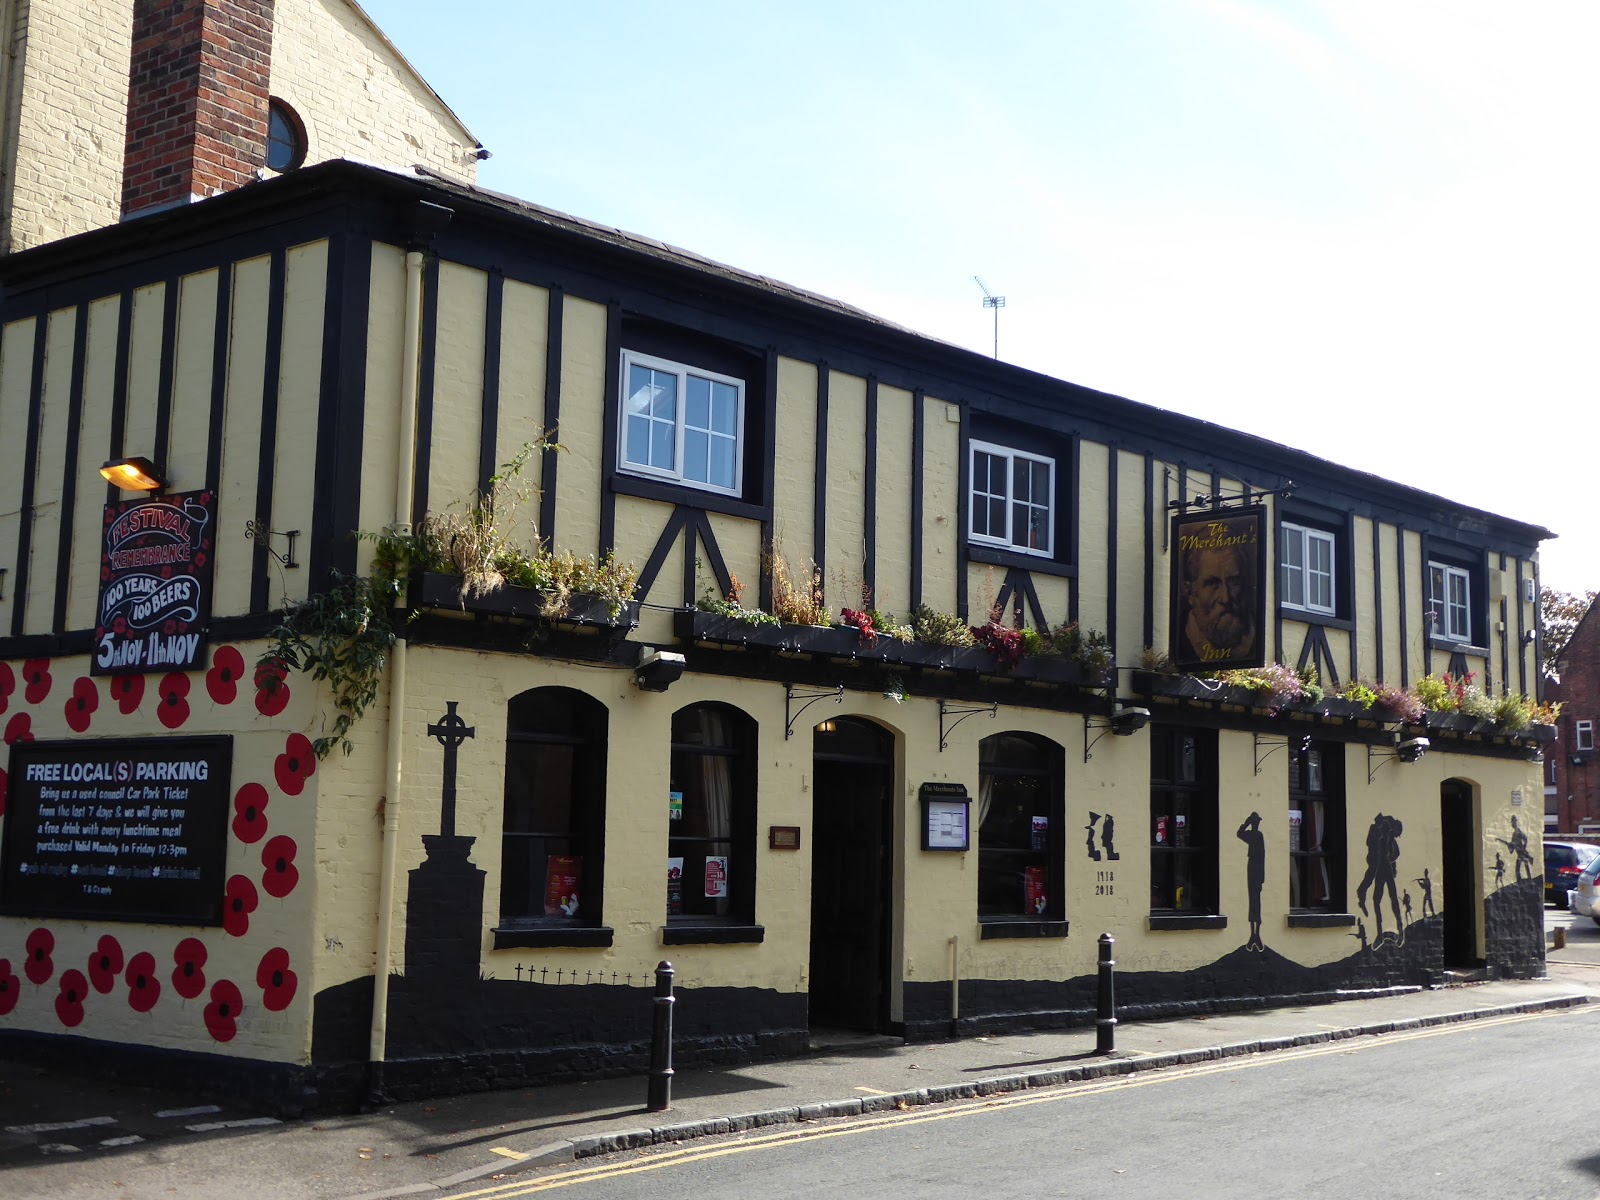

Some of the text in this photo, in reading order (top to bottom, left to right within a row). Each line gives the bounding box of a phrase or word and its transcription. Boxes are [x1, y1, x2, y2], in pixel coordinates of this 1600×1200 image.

[112, 507, 191, 546] FESTIVAL
[1208, 523, 1229, 537] The
[1180, 525, 1257, 551] Merchant's
[111, 542, 191, 571] REMEMBRANCE
[106, 577, 157, 612] 100 YEARS
[133, 581, 191, 621] 100 BEERS
[1201, 643, 1231, 662] Inn
[27, 764, 62, 781] FREE
[136, 760, 208, 780] PARKING
[40, 786, 189, 801] Bring us a used council Car Park Ticket
[924, 785, 964, 794] The Merchants Inn
[39, 804, 186, 821] from the last 7 days & we will give you
[37, 821, 182, 839] a free drink with every lunchtime meal
[36, 838, 73, 854] purchased
[74, 840, 91, 852] Valid
[92, 841, 119, 856] Monday
[121, 843, 130, 853] to
[131, 842, 156, 857] Friday
[1097, 871, 1114, 881] 1918
[1095, 886, 1114, 895] 2018
